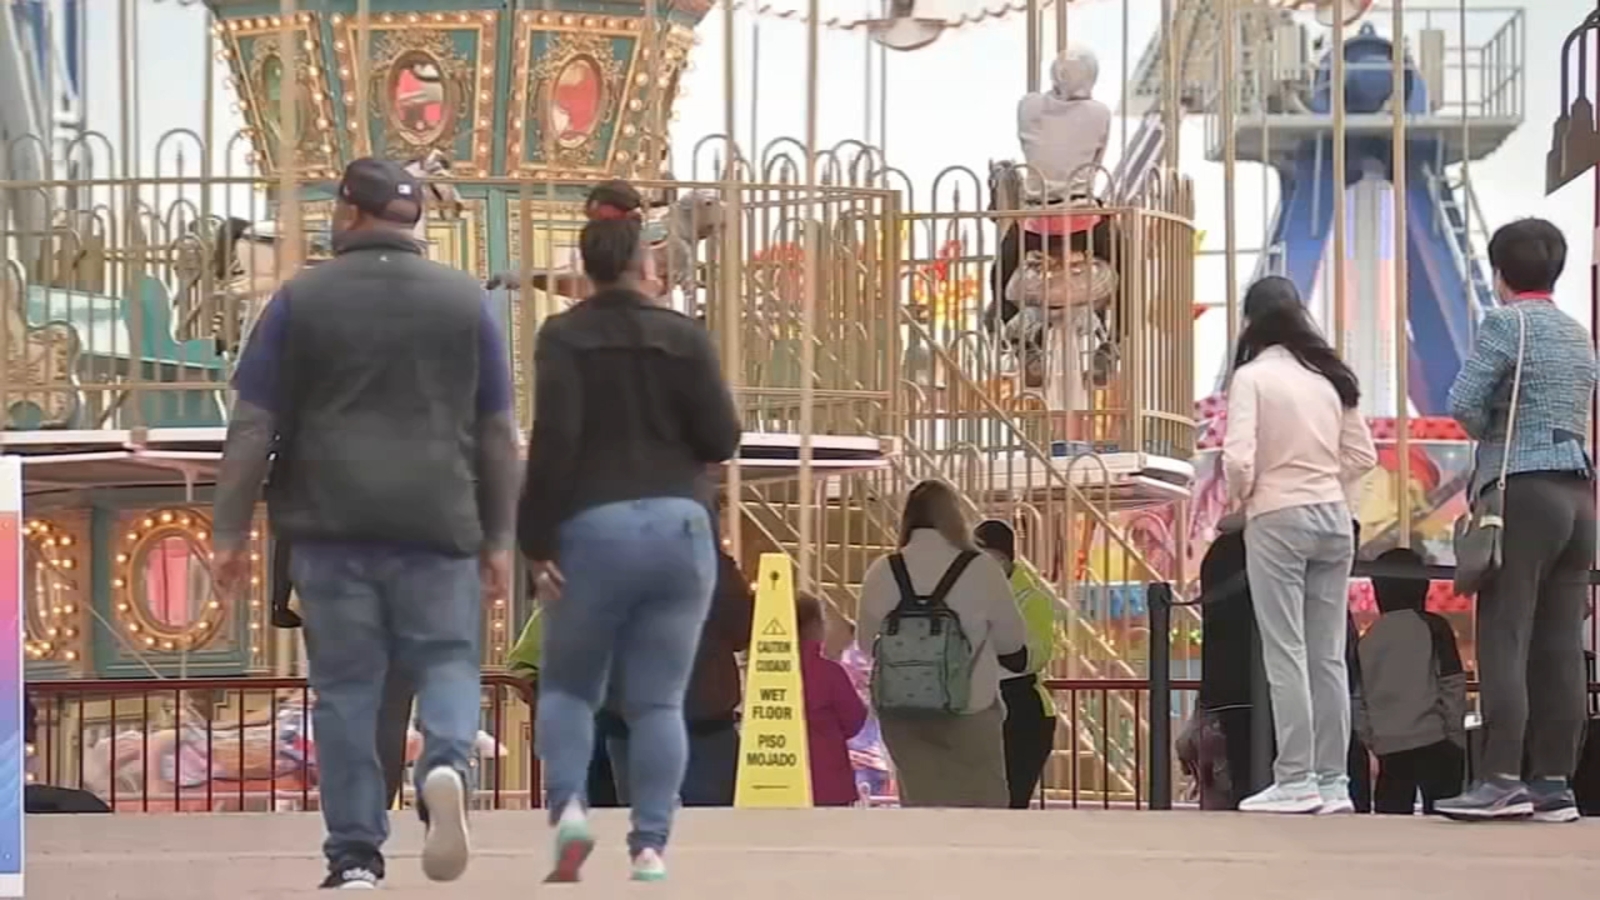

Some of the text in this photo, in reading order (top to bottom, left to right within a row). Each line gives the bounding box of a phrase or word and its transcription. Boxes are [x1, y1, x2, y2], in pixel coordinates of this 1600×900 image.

[759, 688, 787, 702] WET
[752, 705, 792, 720] FLOOR
[758, 734, 786, 749] PISO
[746, 753, 797, 767] MOJADO
